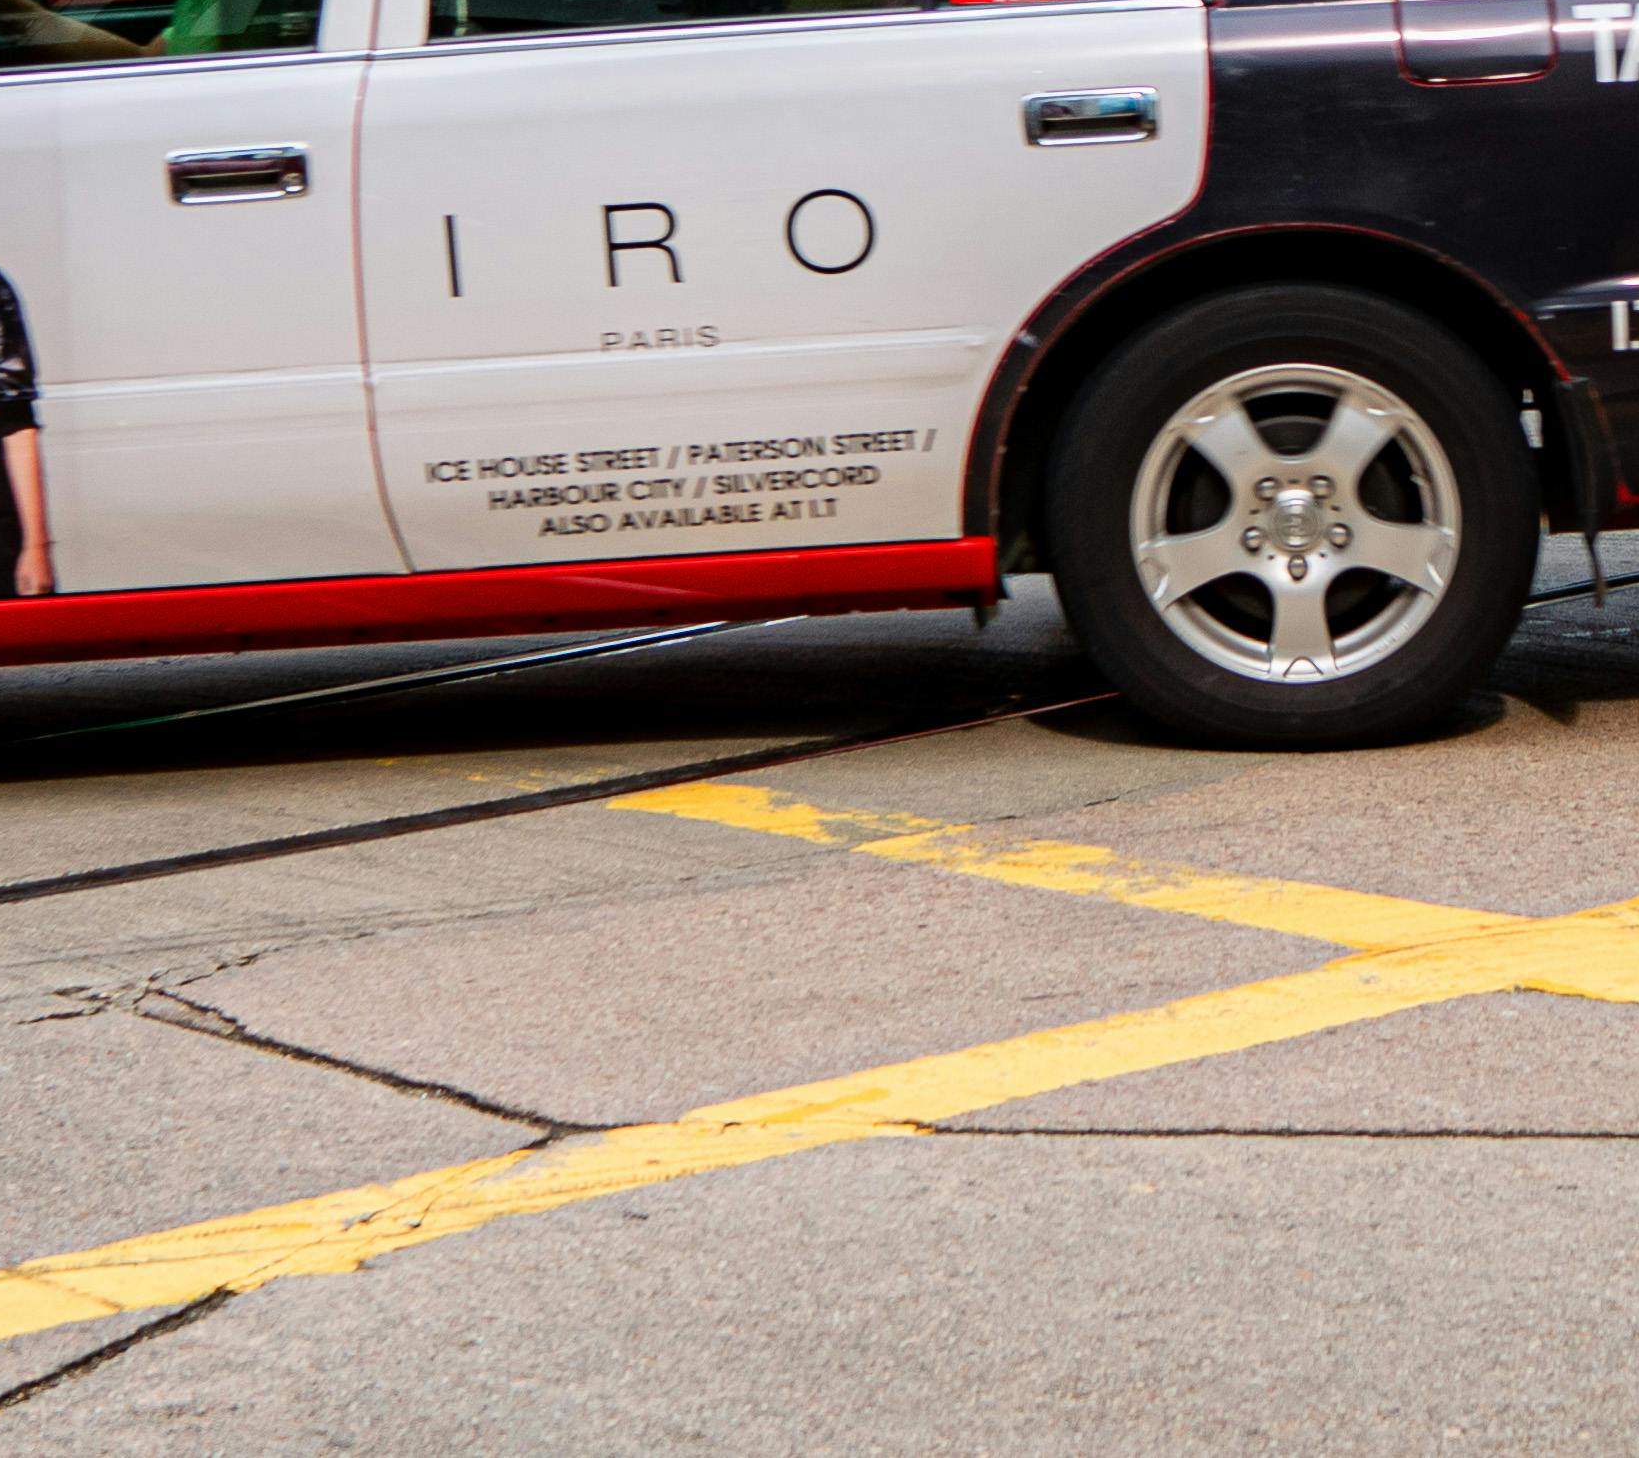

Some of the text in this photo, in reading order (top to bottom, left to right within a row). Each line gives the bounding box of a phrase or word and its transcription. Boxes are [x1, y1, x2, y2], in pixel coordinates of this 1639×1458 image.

[442, 188, 877, 298] IRO
[599, 324, 722, 352] PARIS
[425, 459, 470, 483] ICE
[478, 452, 569, 480] HOUSE
[574, 446, 663, 473] STREET
[687, 435, 828, 466] PATERSON
[832, 428, 918, 456] STREET
[487, 480, 622, 511] HARBOUR
[626, 476, 687, 503] CITY
[712, 464, 882, 497] SILVERCORD
[538, 511, 613, 539] ALSO
[617, 499, 764, 532] AVAILABLE
[768, 498, 804, 523] AT
